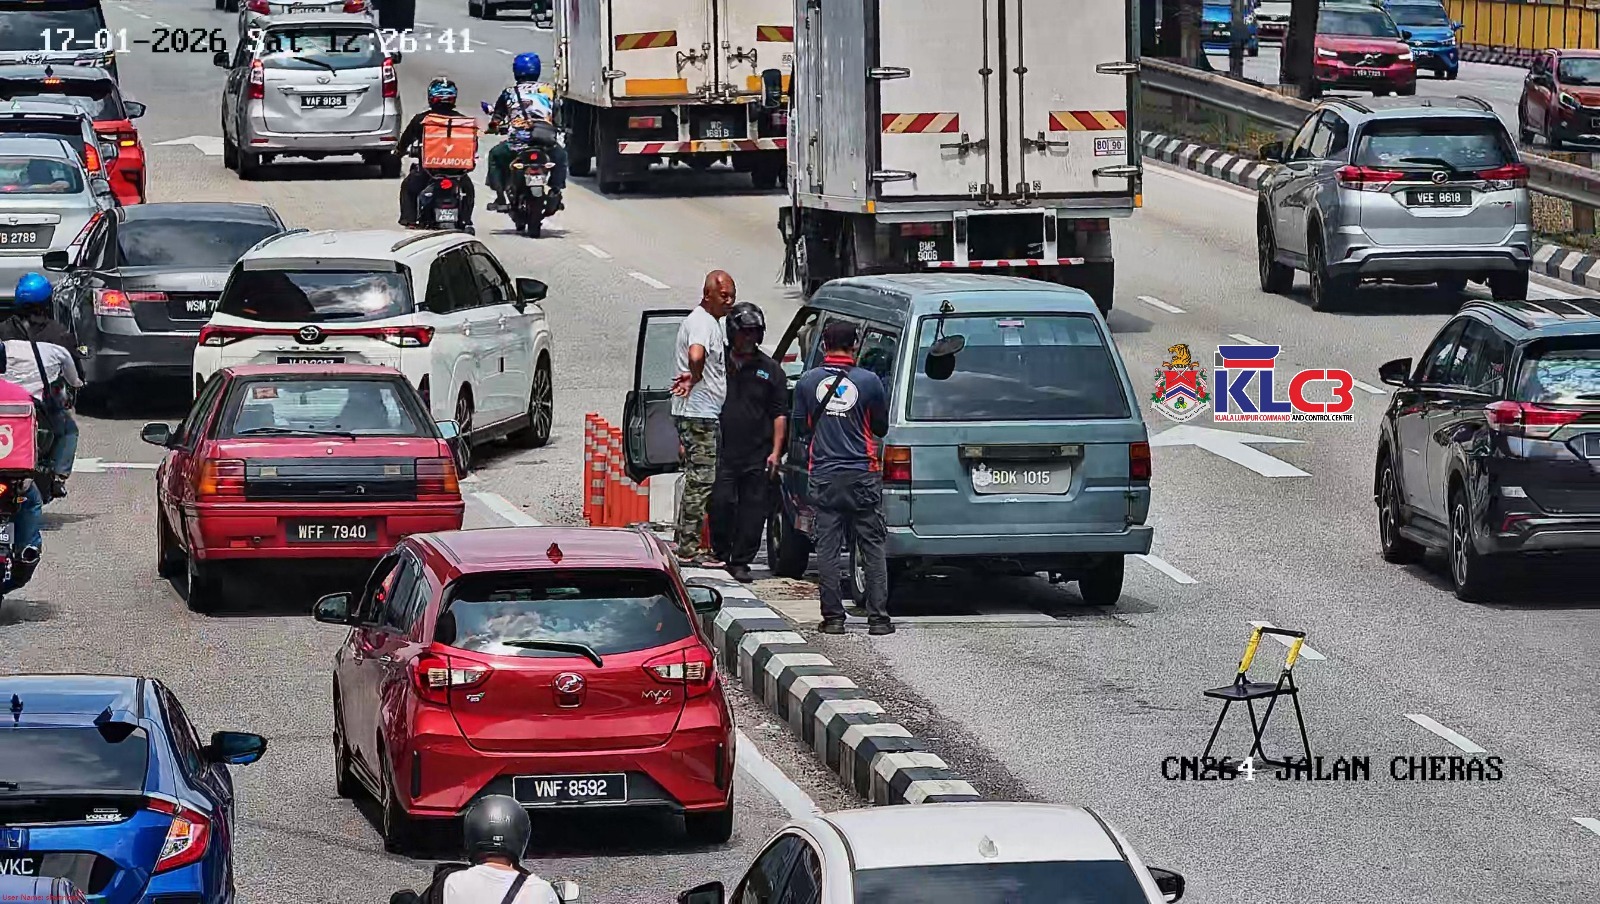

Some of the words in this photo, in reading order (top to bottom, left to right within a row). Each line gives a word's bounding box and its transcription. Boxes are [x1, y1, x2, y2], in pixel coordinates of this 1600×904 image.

[306, 97, 321, 105] VAF
[1097, 140, 1107, 150] 80
[425, 157, 473, 165] LALAMOVE
[1417, 192, 1434, 203] VEE
[1439, 192, 1461, 203] 8618
[11, 231, 36, 243] 2789
[186, 299, 206, 312] WSM
[992, 471, 1017, 484] BDK
[1023, 471, 1050, 484] 1015
[298, 525, 325, 539] WFF
[331, 525, 367, 539] 7940
[534, 780, 563, 797] VNF
[568, 779, 607, 796] 8592
